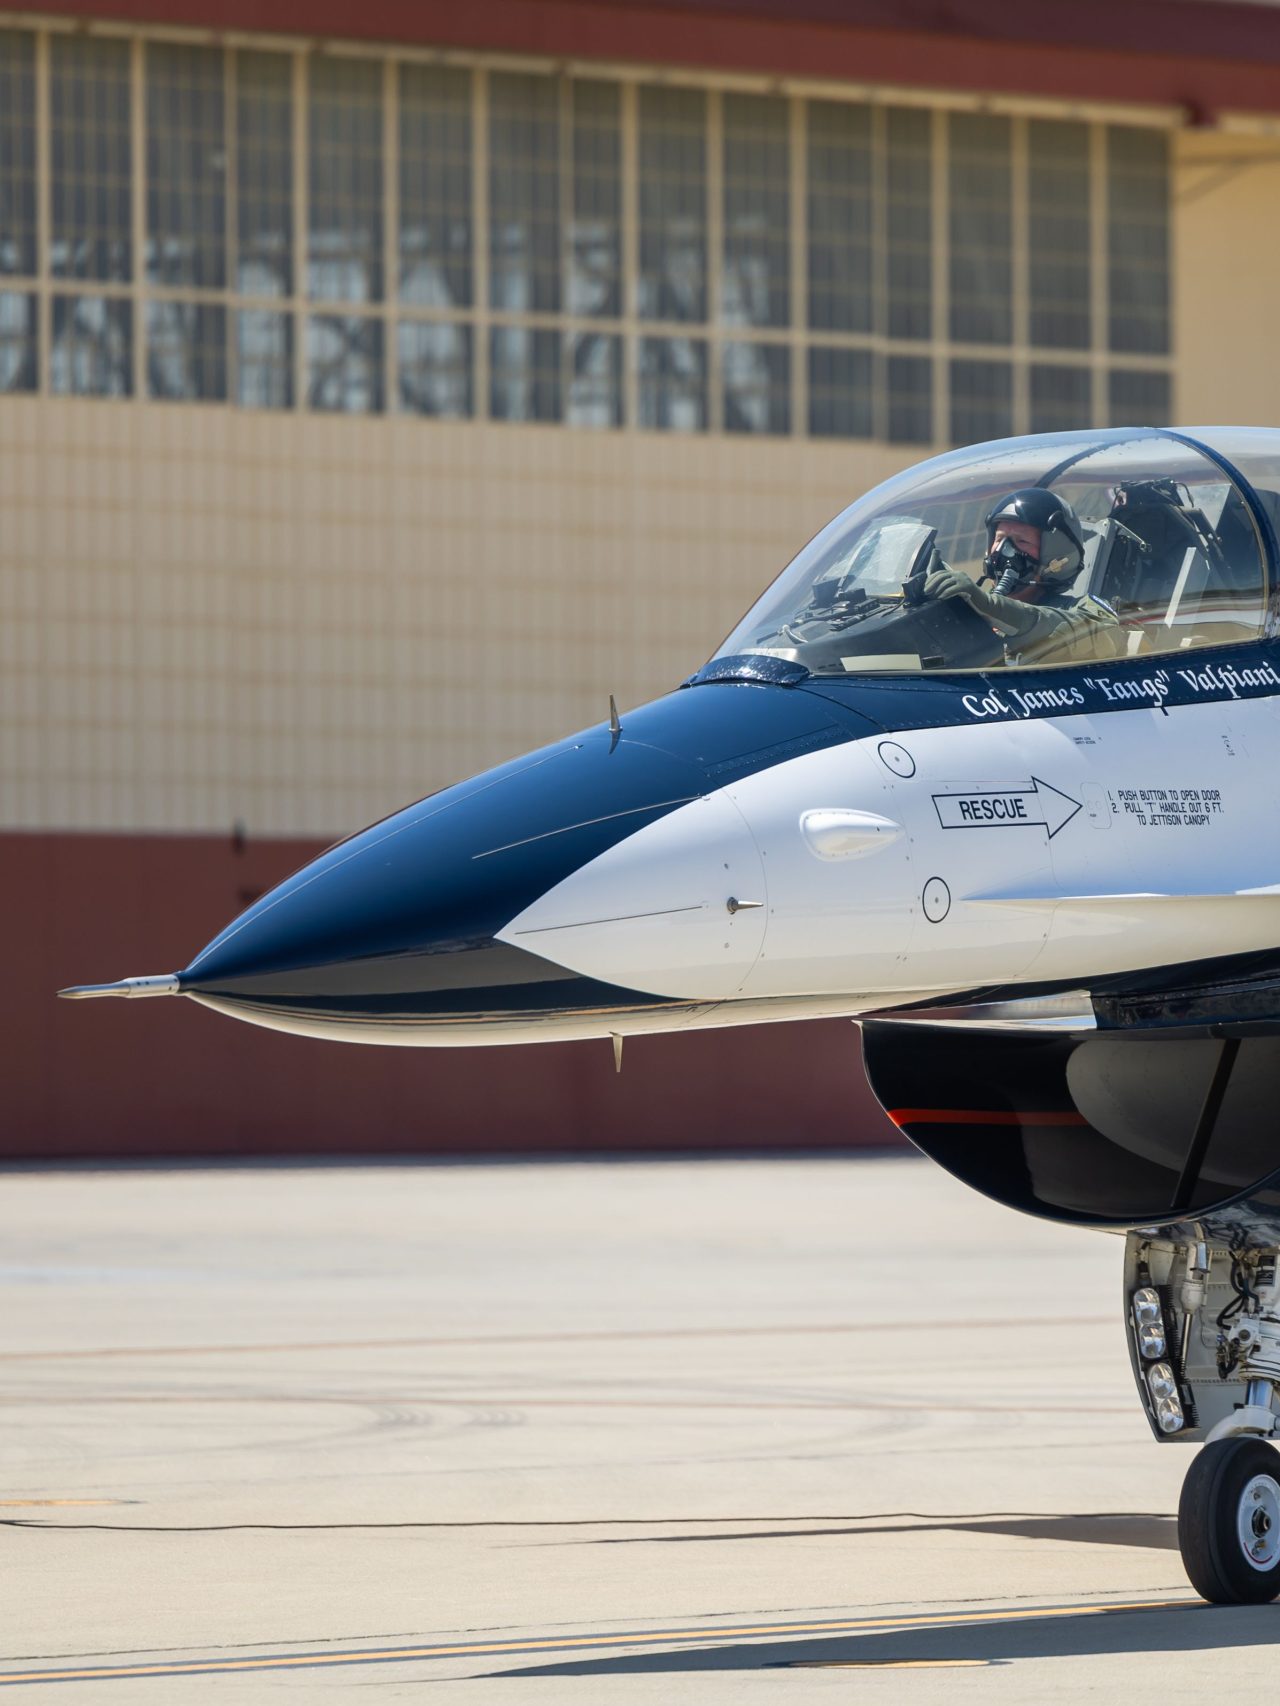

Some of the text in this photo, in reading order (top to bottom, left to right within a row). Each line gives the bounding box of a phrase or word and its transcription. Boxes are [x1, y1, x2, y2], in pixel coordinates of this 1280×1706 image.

[1007, 687, 1085, 718] James
[1083, 669, 1171, 707] "Fangs"
[1107, 790, 1222, 801] 1. PUSH BUTTON TO OPEN DOOR
[958, 798, 1027, 820] RESCUE
[1111, 802, 1225, 813] 2. PULL "T" HANDLE OUT 6 FT.
[1136, 814, 1211, 825] TO JETTISON CANOPY
